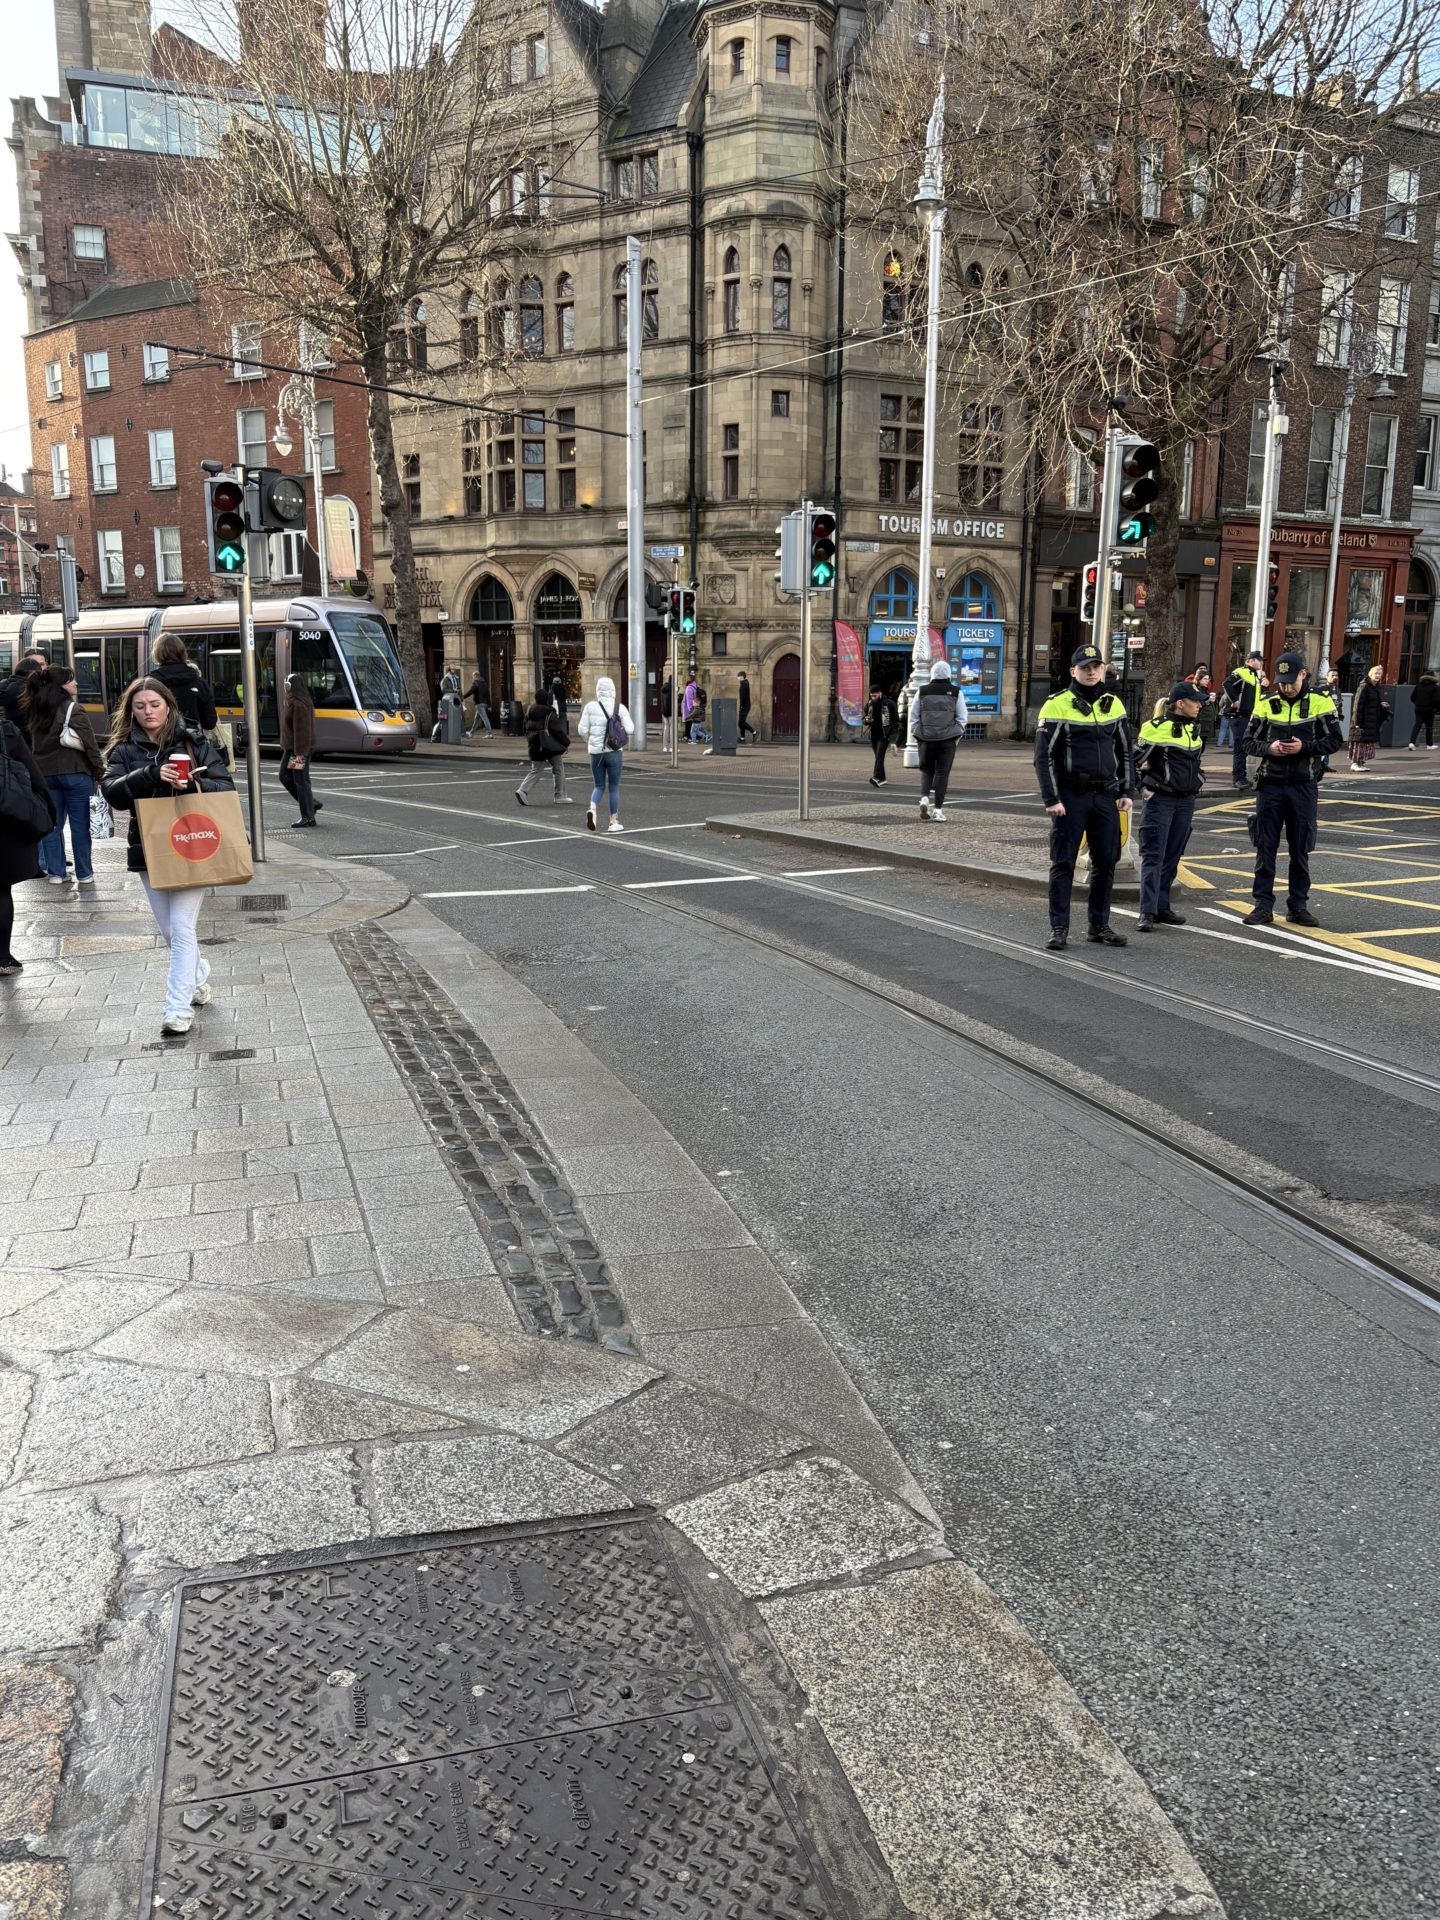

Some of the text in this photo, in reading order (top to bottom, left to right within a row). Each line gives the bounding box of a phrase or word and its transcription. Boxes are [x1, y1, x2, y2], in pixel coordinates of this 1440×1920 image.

[879, 515, 1005, 538] TOURSM OFFICE
[1314, 530, 1327, 544] of
[1329, 532, 1367, 548] Ieland
[299, 631, 321, 640] 5040
[884, 627, 917, 638] TOURS
[957, 628, 994, 638] TICKETS
[567, 1779, 592, 1831] eircom
